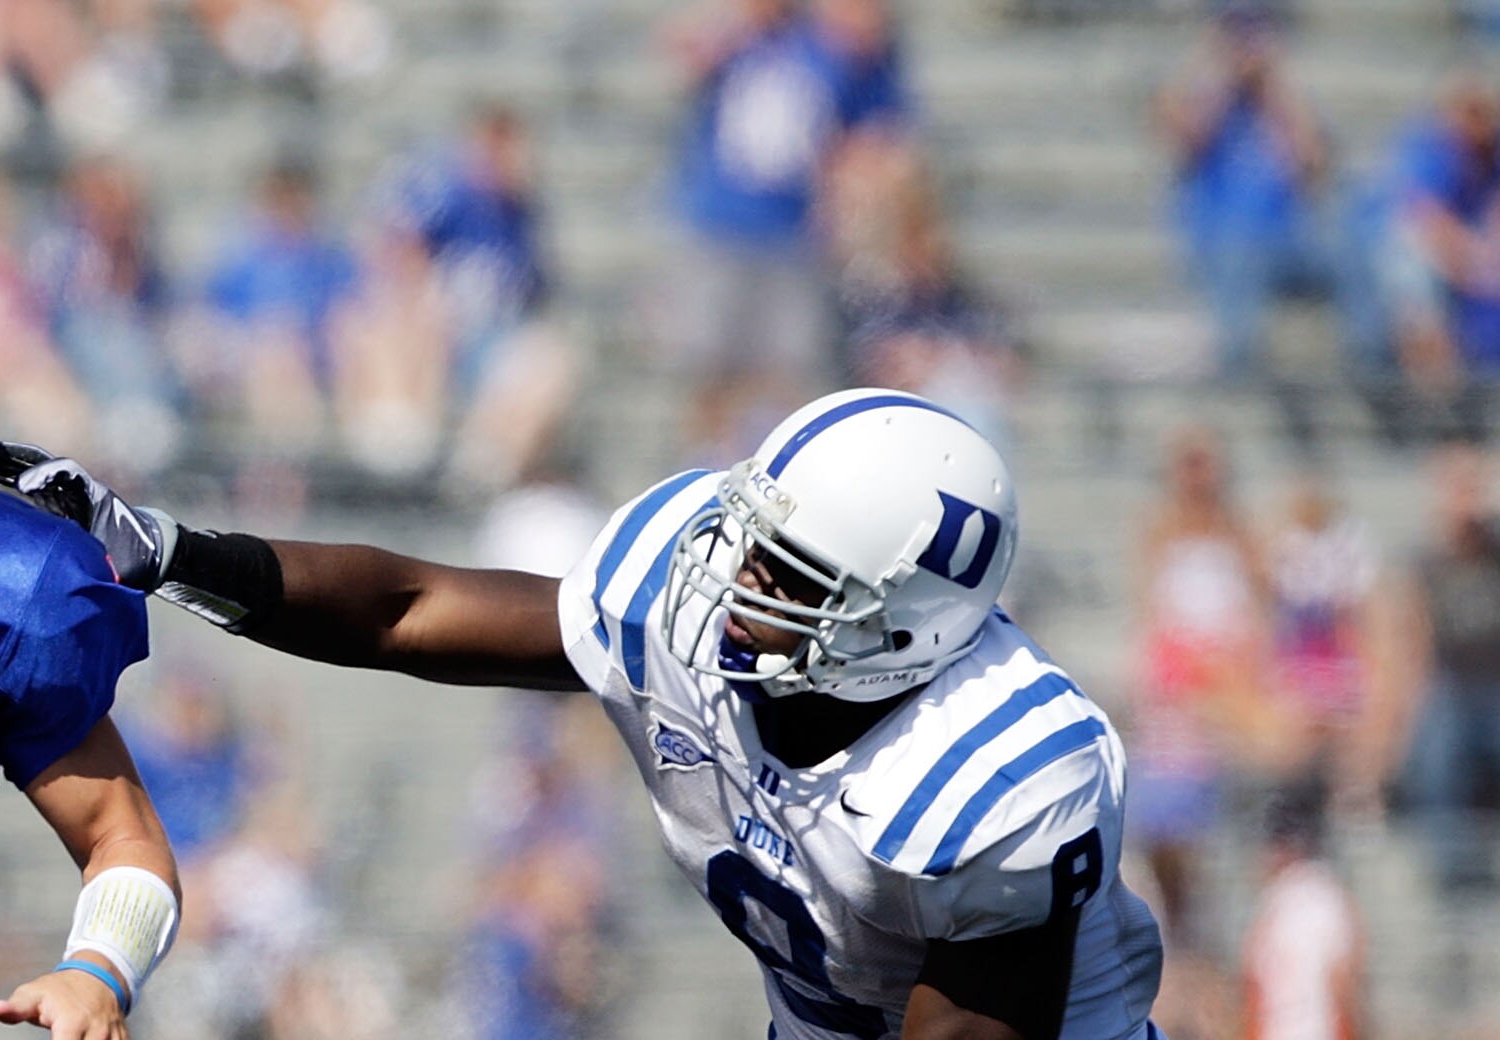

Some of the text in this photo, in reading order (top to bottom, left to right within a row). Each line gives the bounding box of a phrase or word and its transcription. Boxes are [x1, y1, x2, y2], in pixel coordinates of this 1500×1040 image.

[750, 471, 778, 500] ACC
[915, 488, 1002, 589] D
[659, 736, 697, 764] ACC
[734, 815, 794, 866] DUKE
